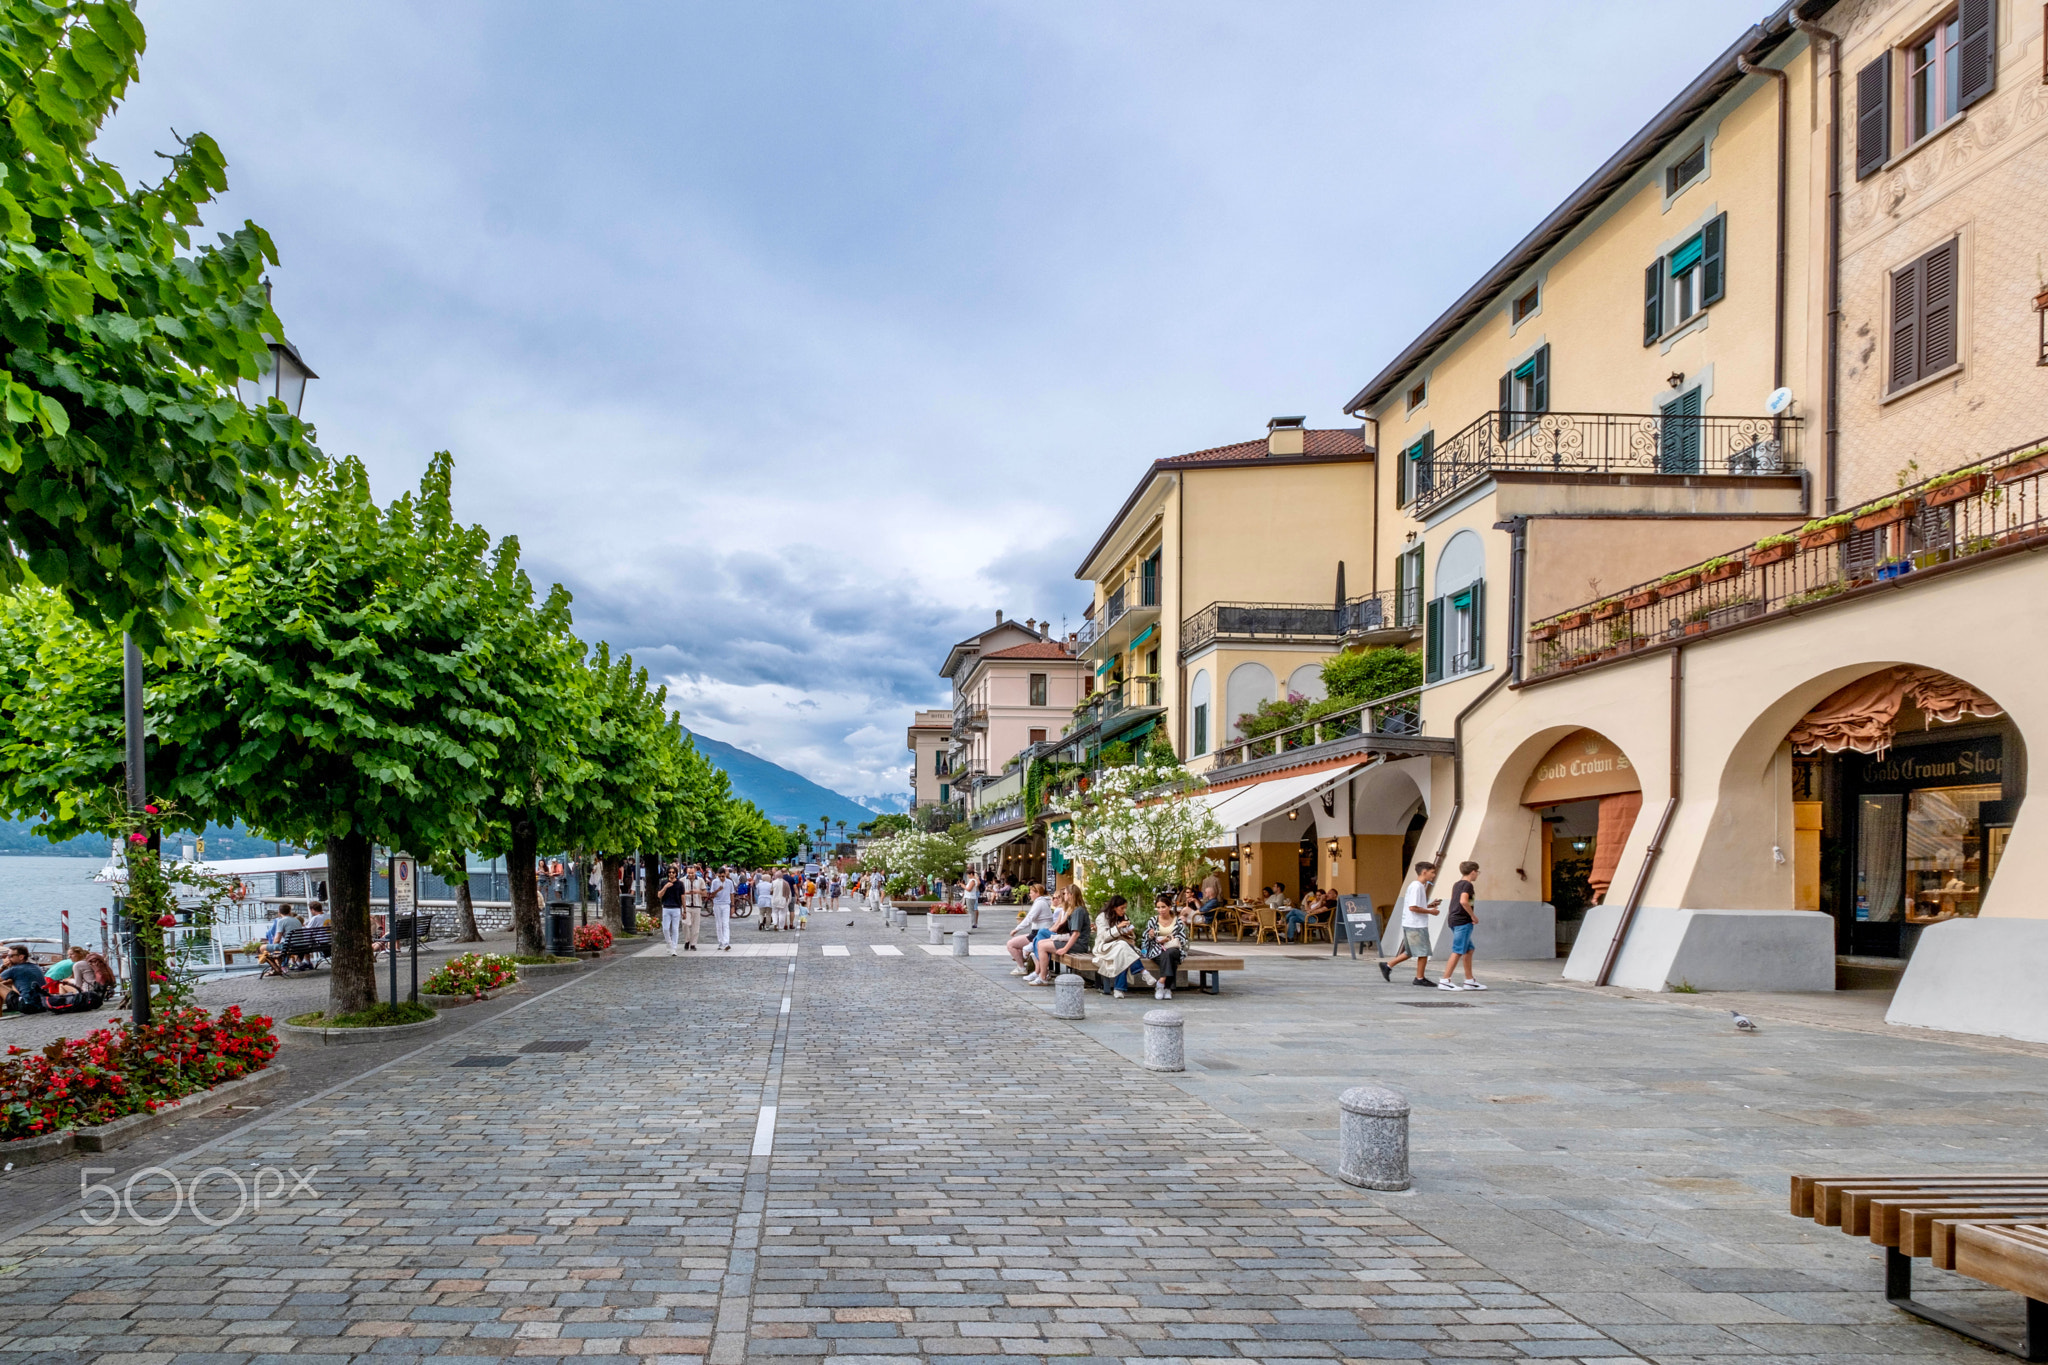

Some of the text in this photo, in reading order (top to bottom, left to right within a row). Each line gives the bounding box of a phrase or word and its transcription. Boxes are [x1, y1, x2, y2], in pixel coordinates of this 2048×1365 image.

[1537, 763, 1567, 781] Gold
[1570, 758, 1613, 777] Crown
[1863, 760, 1900, 783] Gold
[1901, 758, 1956, 780] Crown
